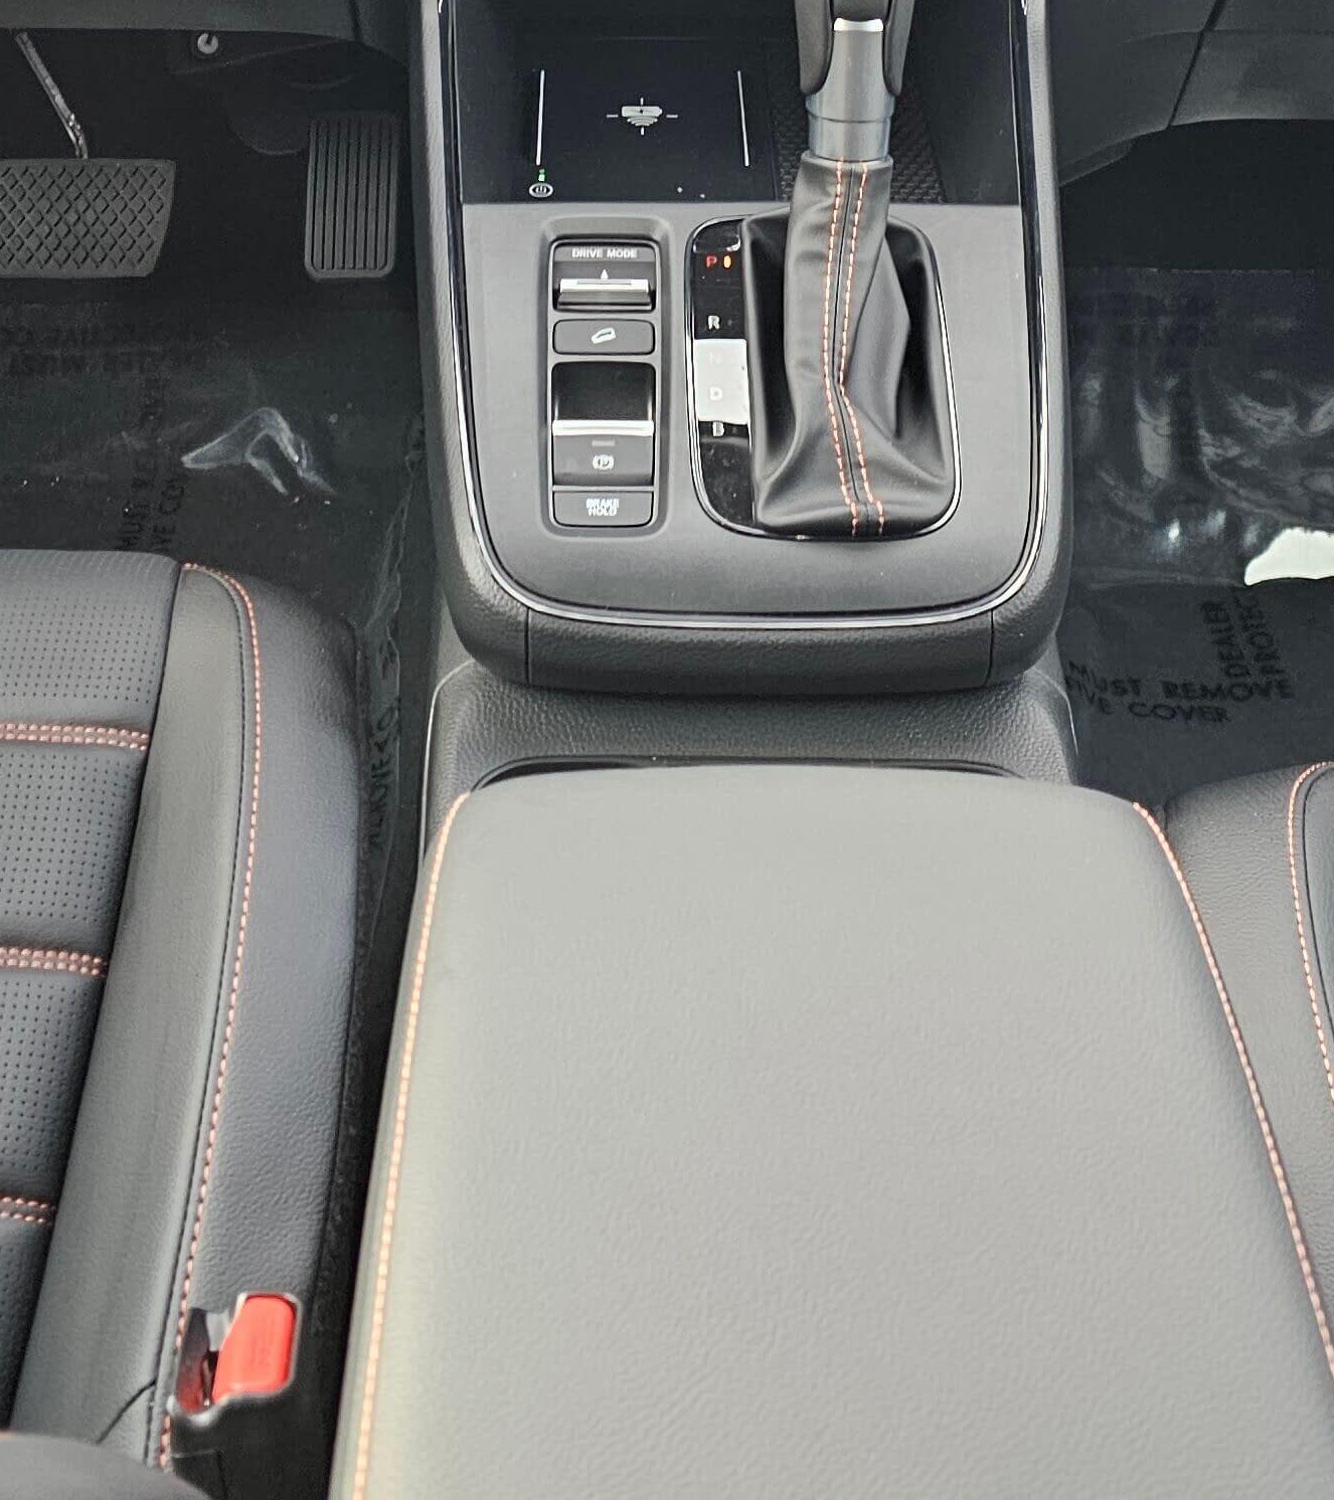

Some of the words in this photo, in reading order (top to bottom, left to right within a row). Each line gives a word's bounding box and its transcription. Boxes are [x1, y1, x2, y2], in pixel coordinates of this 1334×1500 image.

[571, 247, 604, 259] DRIVE
[606, 247, 638, 259] MODE
[706, 254, 718, 269] P
[707, 314, 721, 330] R
[709, 386, 724, 401] D
[712, 421, 725, 437] B
[585, 497, 620, 509] BRAKE
[587, 508, 618, 517] HOLD
[1162, 679, 1295, 702] REMOVE
[1128, 701, 1232, 724] COVER
